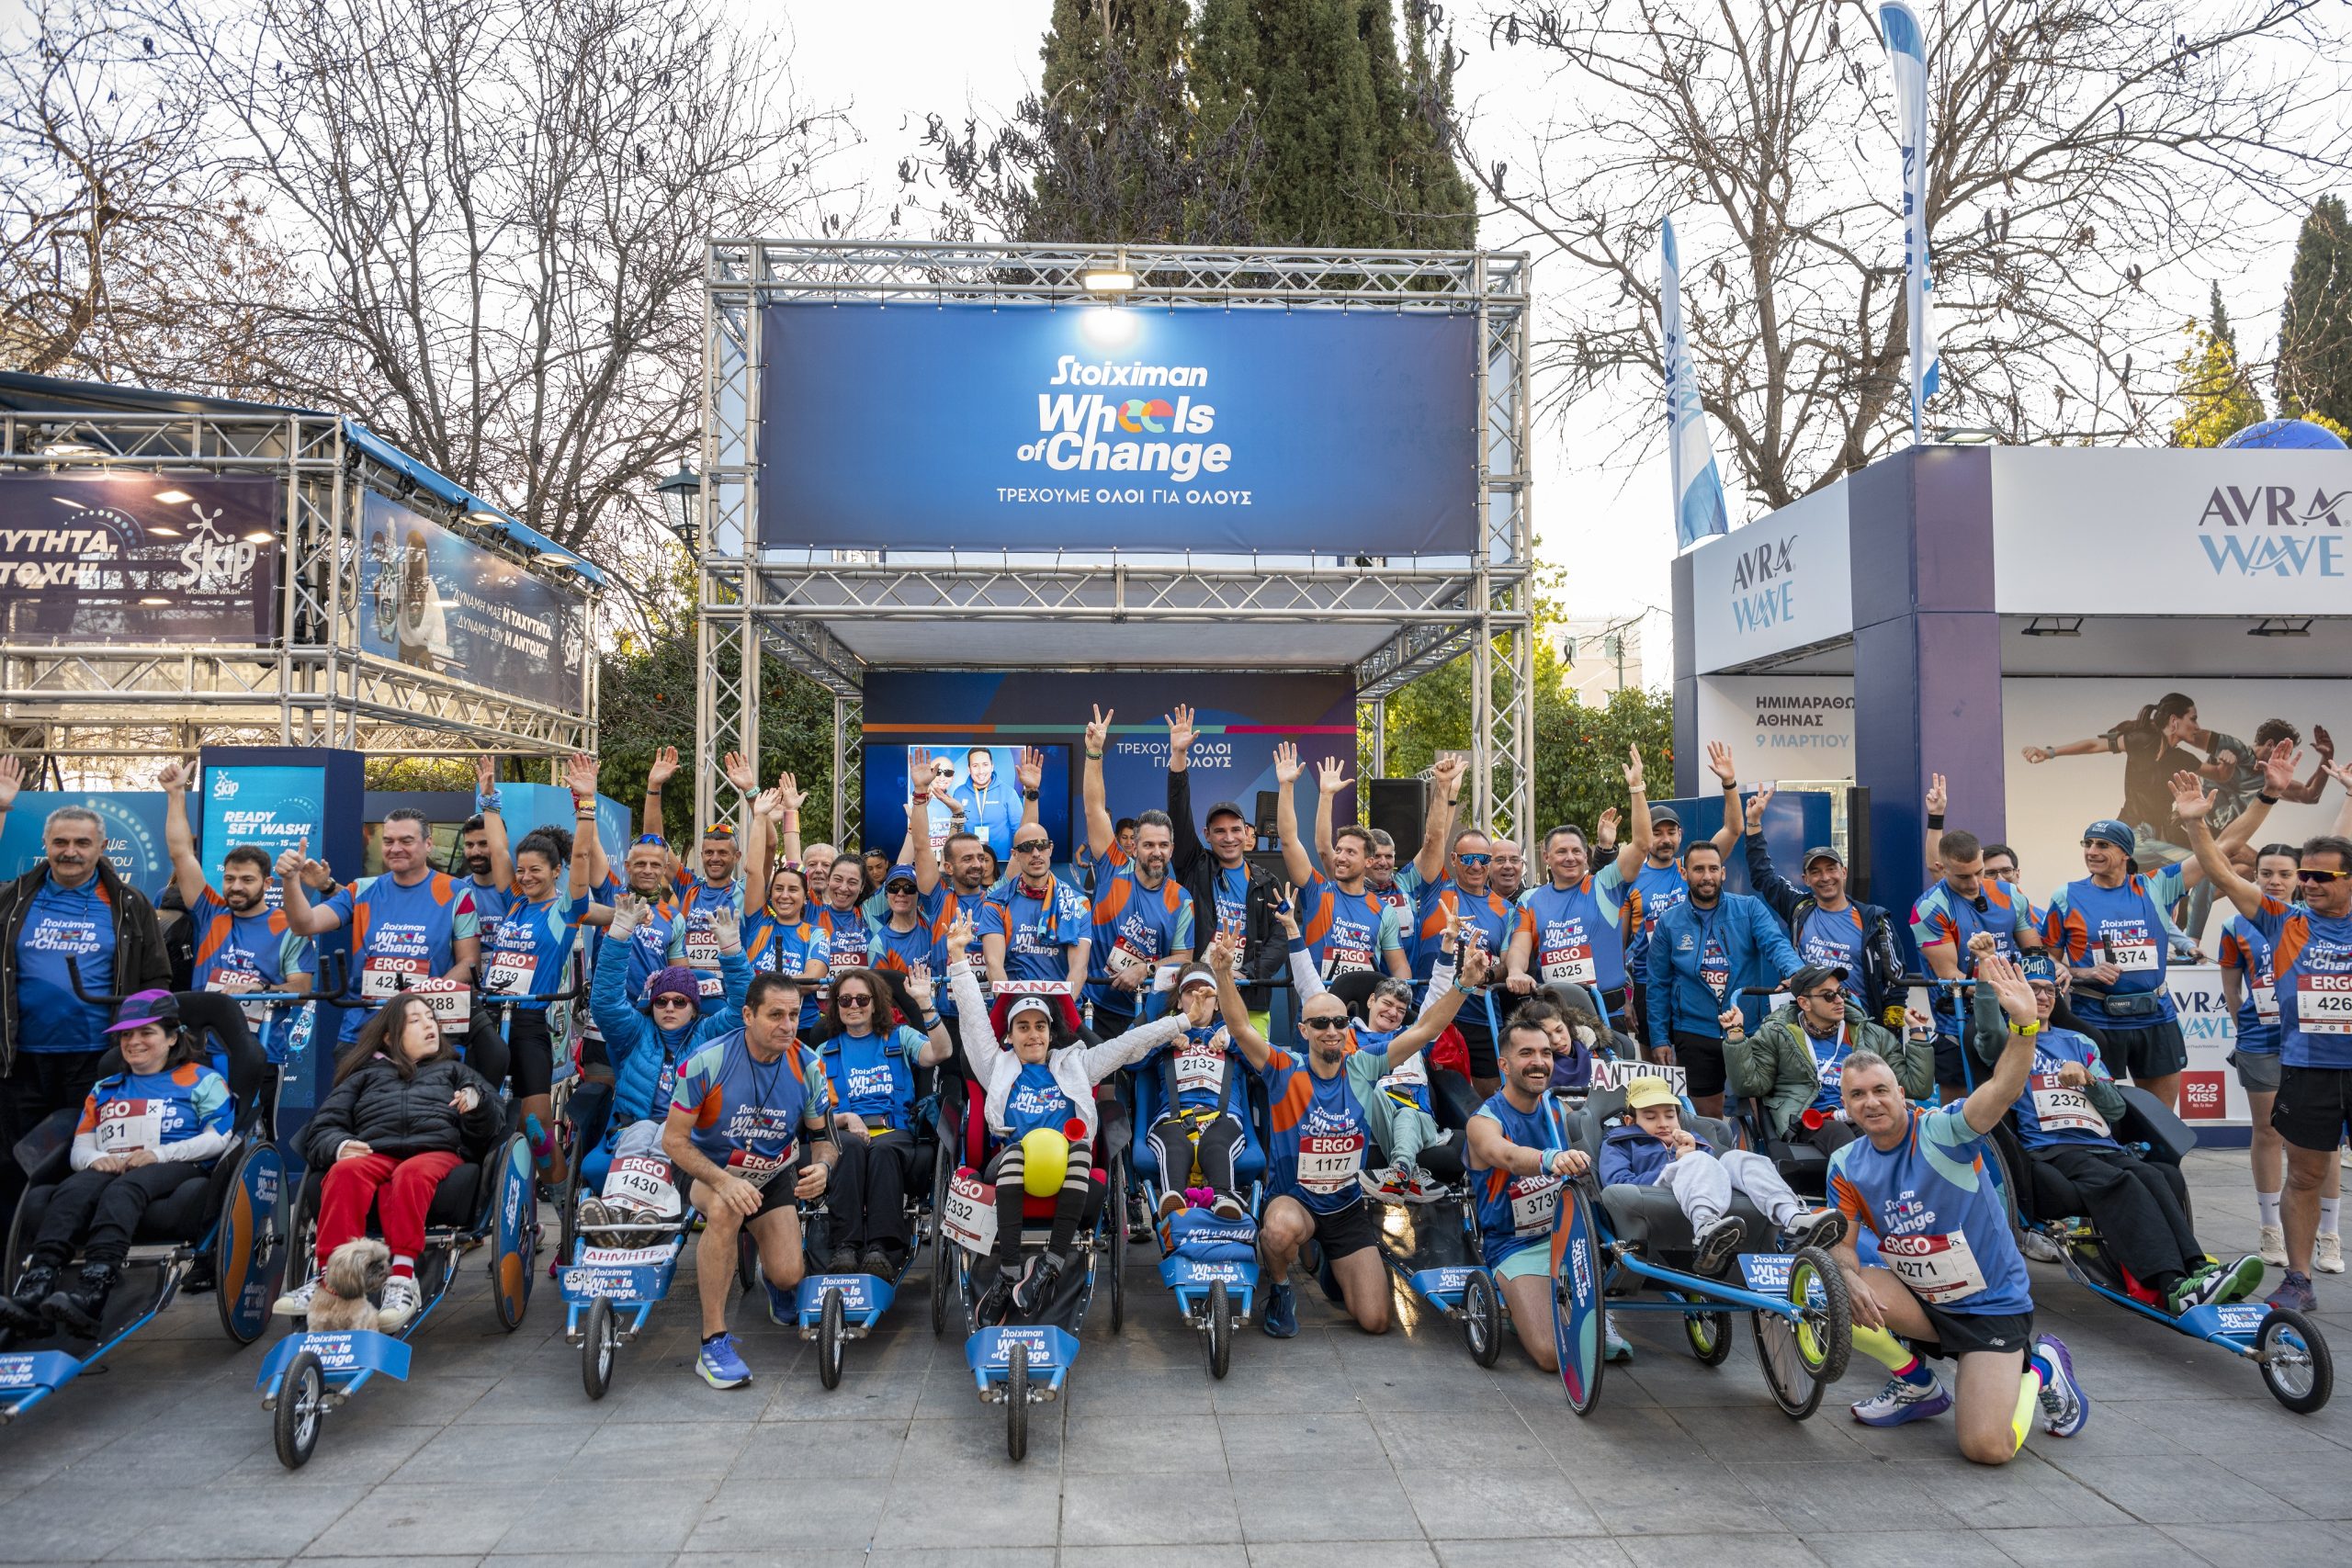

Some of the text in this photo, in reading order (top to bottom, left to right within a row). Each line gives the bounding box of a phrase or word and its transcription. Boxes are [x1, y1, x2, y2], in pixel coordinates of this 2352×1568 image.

[1049, 355, 1207, 387] Stoiximan
[1037, 393, 1215, 435] Wheels
[1017, 432, 1231, 483] of Change
[997, 488, 1252, 505] ΤΡΕΧΟΥΜΕ ΟΛΟΙ ΓΙΑ ΟΛΟΥΣ
[2199, 485, 2352, 527] AVRA
[178, 534, 256, 585] Skip
[2199, 535, 2345, 577] WAVE
[1733, 536, 1798, 594] AVRA
[453, 590, 485, 610] ΔΥΝΑΜΗ
[487, 604, 502, 620] ΜΑΣ
[503, 607, 510, 621] Η
[1733, 581, 1793, 635] WAVE
[458, 615, 548, 660] ΔΥΝΑΜΗ ΣΟΥ Η ΑΝΤΟΧΗ!
[1756, 714, 1824, 727] ΑΘΗΝΑΣ
[1756, 734, 1849, 748] 9 ΜΑΡΤΙΟΥ
[1193, 743, 1231, 754] ΟΛΟΙ
[223, 812, 277, 822] READY
[228, 824, 311, 835] SET WASH!
[41, 918, 95, 930] Stoiximan
[380, 922, 425, 931] Stoiximan
[1335, 917, 1370, 931] Stoiximan
[2100, 919, 2144, 929] Stoiximan
[33, 928, 96, 942] Wheels
[375, 931, 426, 943] Wheels
[1547, 934, 1588, 948] Change
[25, 938, 100, 954] of Change
[377, 942, 429, 955] Change
[1019, 943, 1058, 956] Change
[1809, 936, 1850, 950] Stoiximan
[690, 949, 718, 960] 4372
[1546, 949, 1580, 964] ERGO
[374, 958, 417, 972] ERGO
[1552, 964, 1582, 978] 4325
[411, 979, 457, 993] ERGO
[993, 982, 1070, 993] NANA
[2312, 976, 2352, 989] ERG
[851, 1065, 889, 1077] Stoiximan
[1182, 1057, 1215, 1072] 2132
[854, 1084, 894, 1098] Chang
[2187, 1084, 2218, 1093] 92.9
[2050, 1094, 2086, 1109] 2327
[2188, 1093, 2217, 1102] KISS
[1017, 1100, 1066, 1113] Chage
[729, 1127, 787, 1140] Change
[1312, 1138, 1354, 1153] ERGO
[621, 1158, 666, 1177] ERGO
[742, 1153, 784, 1170] ERGO
[1316, 1157, 1351, 1171] 1177
[622, 1175, 659, 1195] 1430
[951, 1175, 983, 1199] ERGO
[947, 1197, 973, 1221] 2332
[1884, 1236, 1931, 1255] ERGO
[1192, 1264, 1234, 1273] Wheels
[1581, 1238, 1591, 1289] Stoiximan
[1896, 1260, 1937, 1278] 4271
[821, 1278, 859, 1286] Stoiximan
[1194, 1272, 1238, 1283] Change
[1572, 1248, 1586, 1308] Change
[588, 1287, 637, 1299] Change
[304, 1334, 352, 1344] Stoiximan
[1001, 1329, 1044, 1338] Stoiximan
[320, 1354, 355, 1367] ange
